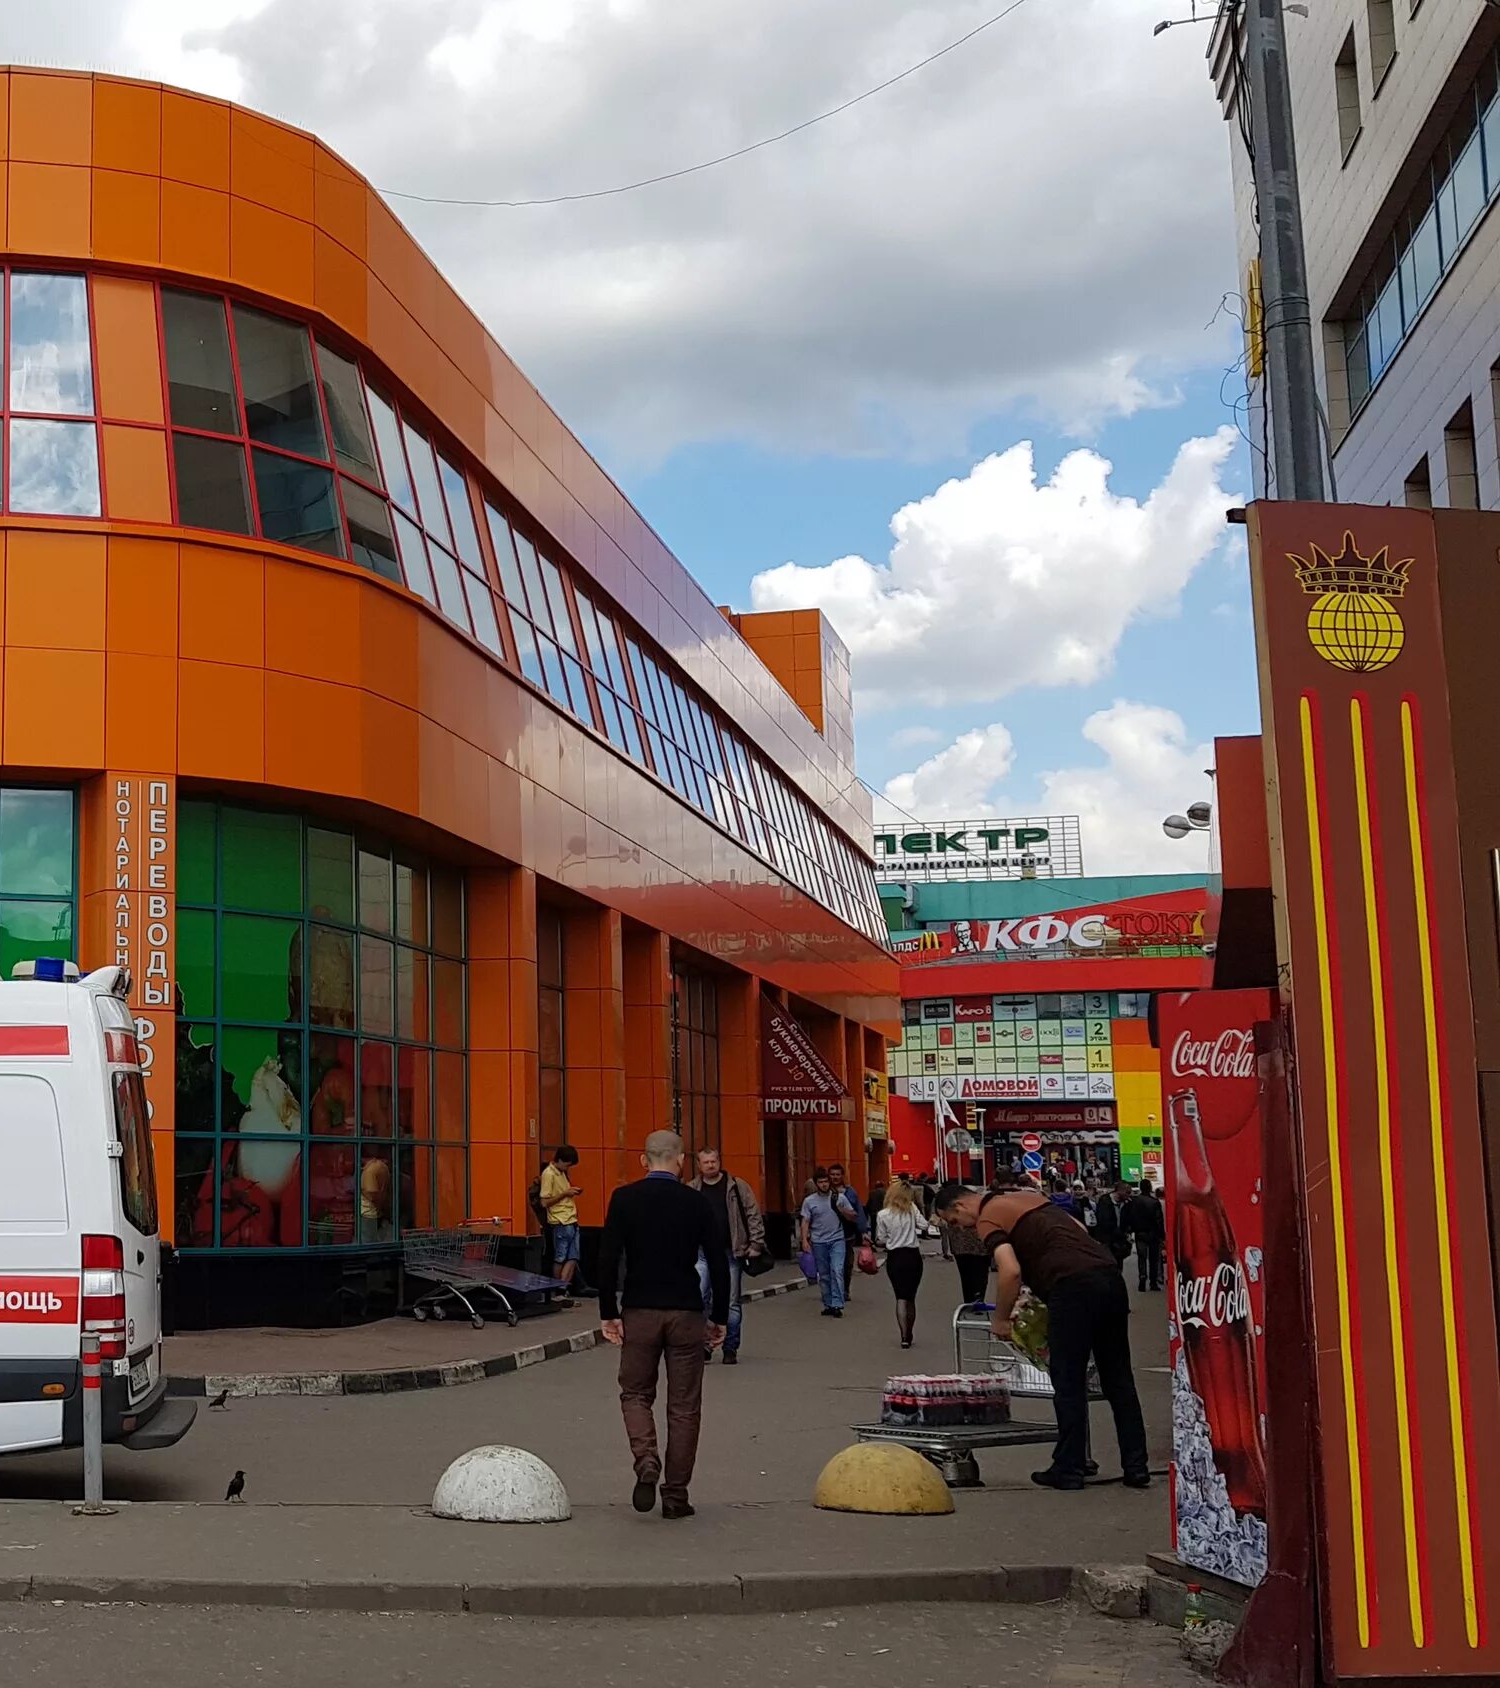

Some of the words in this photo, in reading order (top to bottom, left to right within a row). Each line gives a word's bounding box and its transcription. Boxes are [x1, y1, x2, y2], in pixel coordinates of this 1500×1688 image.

[874, 827, 1049, 855] ПЕКТР
[875, 857, 1007, 872] О-РАЗВЛЕКАТЕЛЬНЫЙ
[1011, 856, 1051, 867] ЦЕНТР
[115, 781, 131, 1002] НОТАРИАЛЬН
[145, 782, 169, 1005] ПЕРЕВОДЫ
[984, 914, 1106, 951] КФС
[1113, 911, 1204, 936] TOKY
[1093, 996, 1102, 1009] 3
[1094, 1022, 1104, 1036] 2
[768, 1038, 793, 1066] клуб
[770, 1016, 830, 1092] Букмекерский
[1095, 1049, 1102, 1062] 1
[1171, 1029, 1254, 1077] Coca-Cola
[765, 1098, 841, 1115] ПРОДУКТЫ
